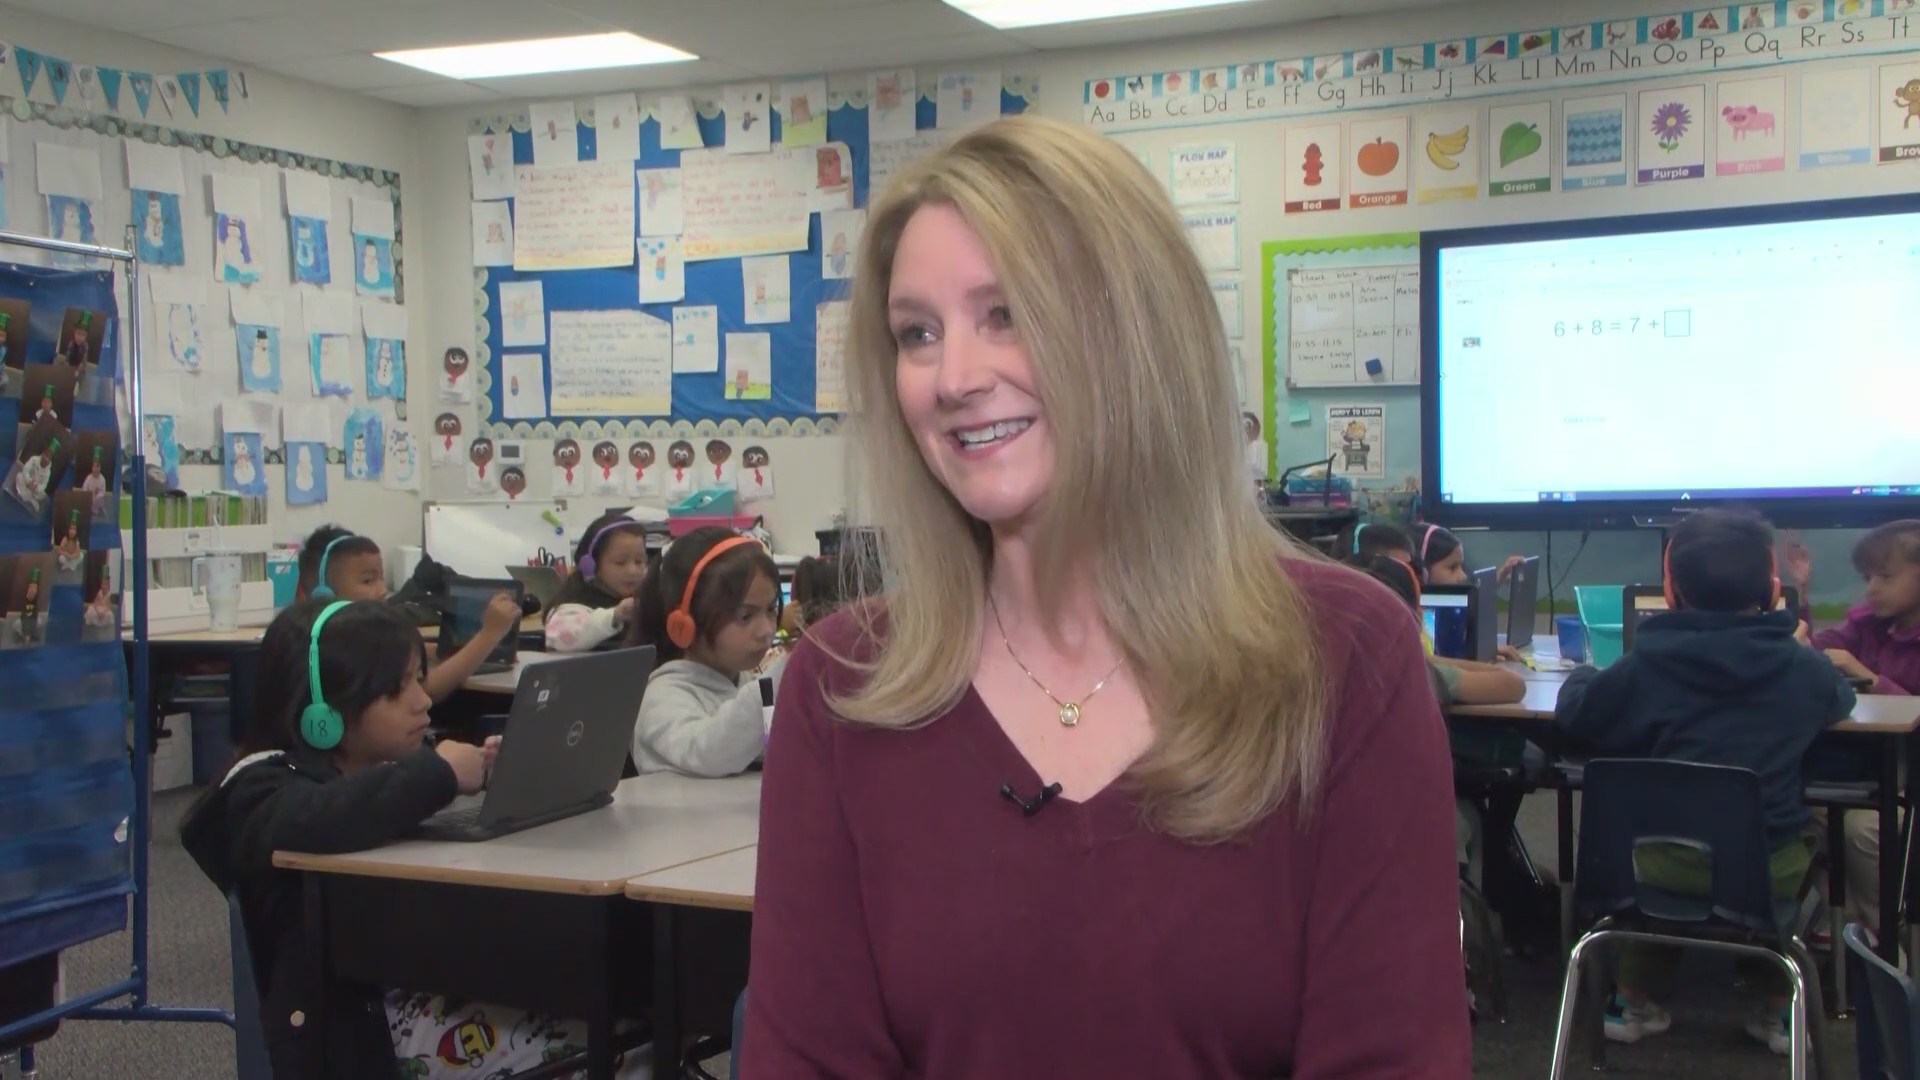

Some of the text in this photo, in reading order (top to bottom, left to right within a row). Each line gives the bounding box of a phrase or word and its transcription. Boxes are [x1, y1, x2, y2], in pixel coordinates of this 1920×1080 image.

[1091, 16, 1909, 123] Aa Bb Cc Dd Ee Ff Gg Hh Ii Jj Kk Ll Mm Nn Oo Pp Qq Rr Ss Tt
[1179, 149, 1228, 162] FLOW MAP
[1652, 167, 1690, 180] Purple
[1502, 181, 1536, 193] Green
[1302, 200, 1322, 211] Red
[1358, 193, 1398, 206] Orange
[1215, 215, 1236, 226] MAP
[1554, 316, 1659, 337] 6 + 8 = 7 +
[1352, 408, 1361, 416] TO
[310, 719, 328, 737] 18
